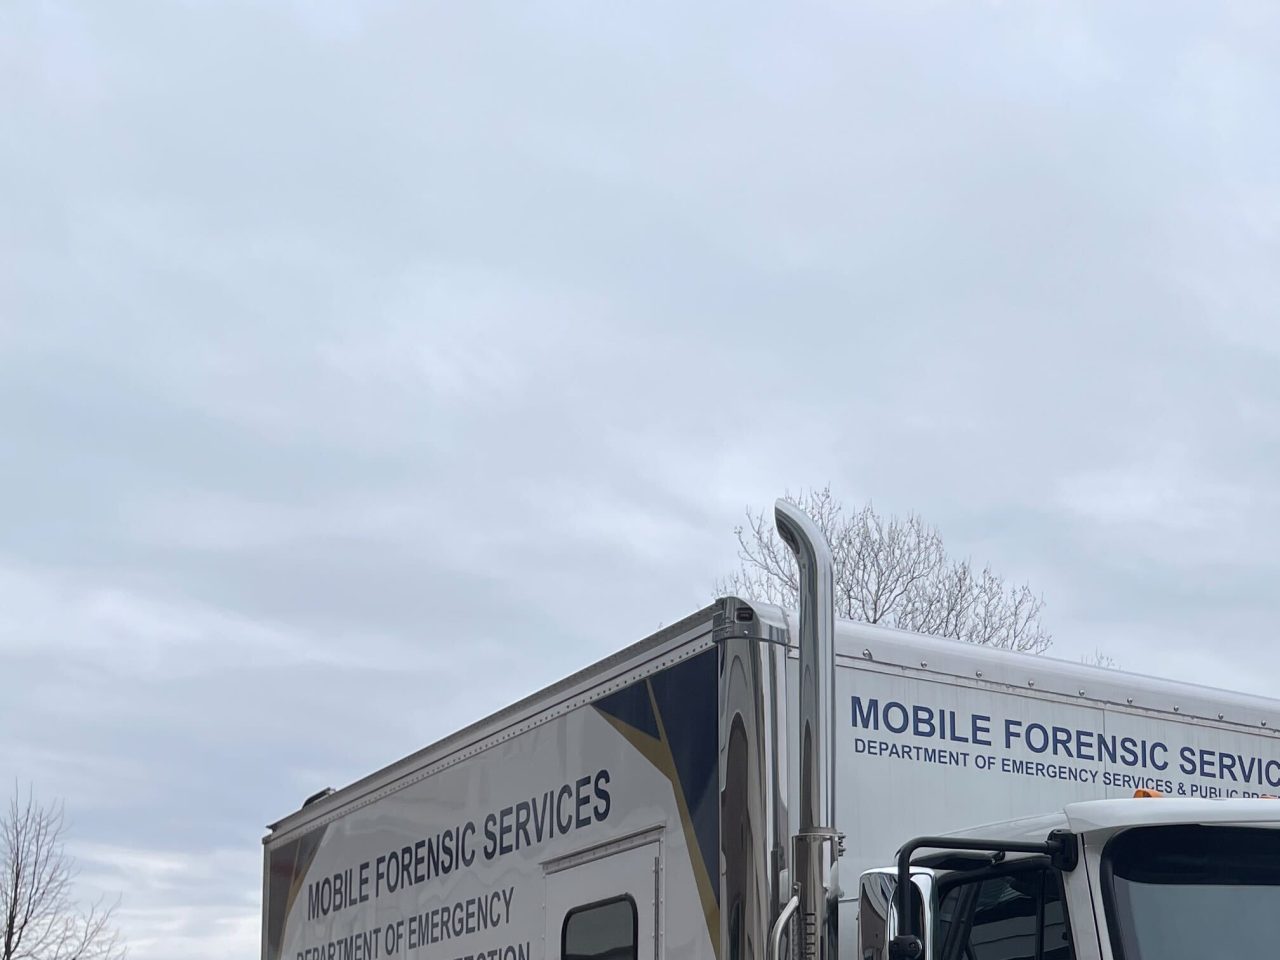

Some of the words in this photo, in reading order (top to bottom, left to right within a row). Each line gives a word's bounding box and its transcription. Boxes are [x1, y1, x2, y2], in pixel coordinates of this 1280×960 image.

[851, 695, 992, 747] MOBILE
[1004, 719, 1168, 771] FORENSIC
[854, 738, 970, 767] DEPARTMENT
[975, 754, 996, 770] OF
[1001, 758, 1098, 784] EMERGENCY
[1102, 771, 1172, 794] SERVICES
[1177, 782, 1187, 796] &
[307, 861, 370, 921] MOBILE
[376, 821, 476, 898] FORENSIC
[484, 769, 611, 861] SERVICES
[385, 920, 404, 956] OF
[408, 887, 514, 951] EMERGENCY
